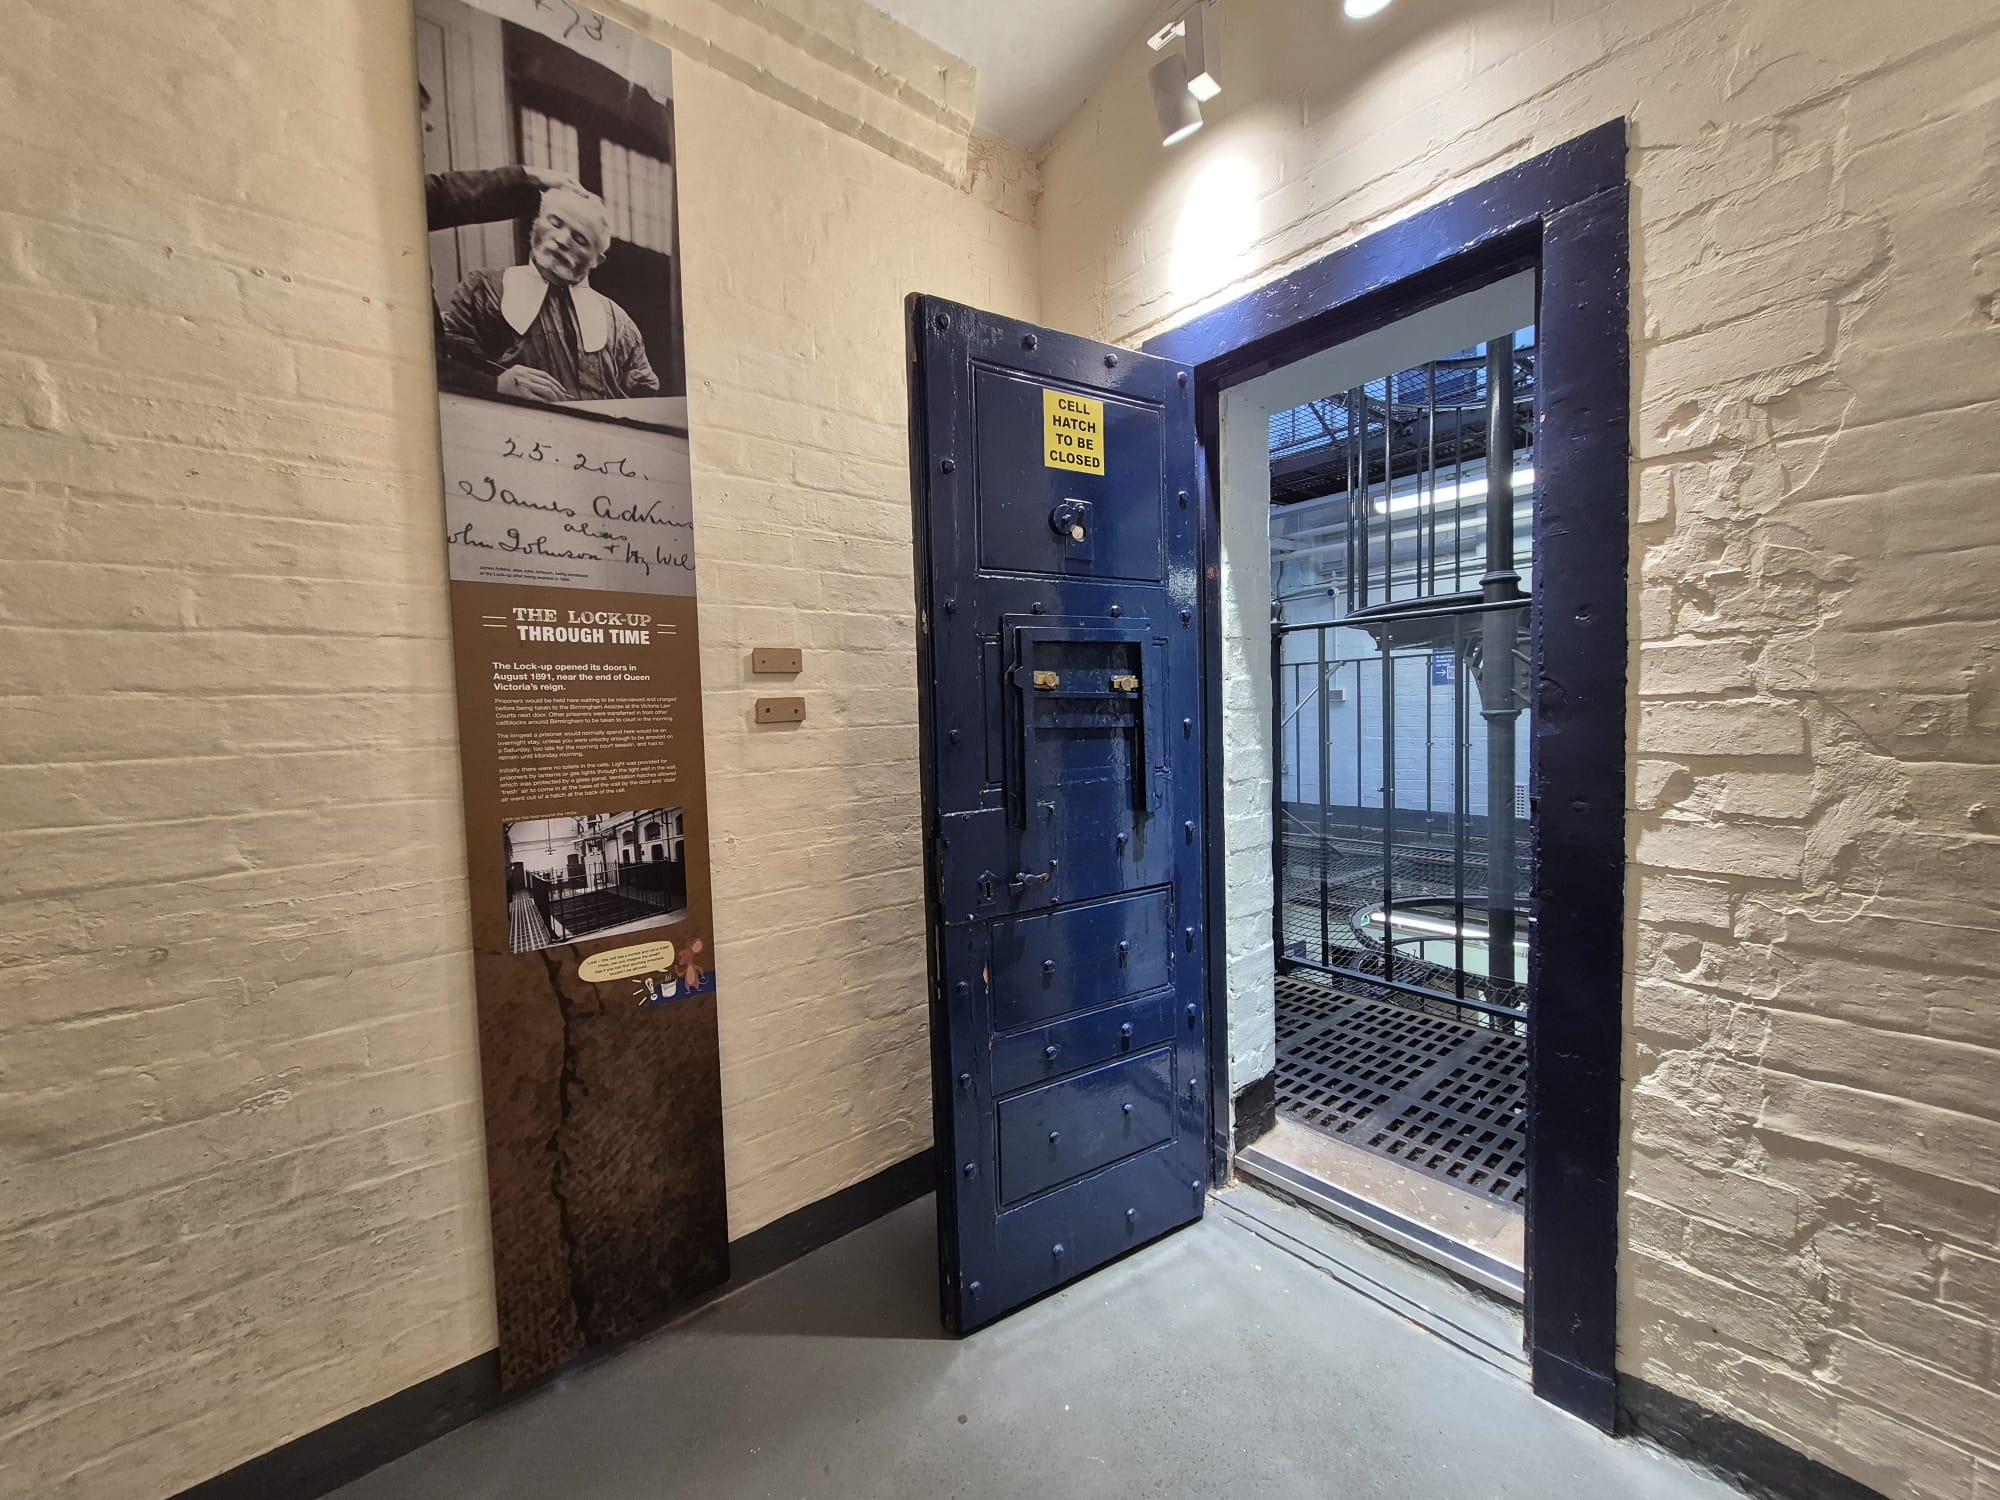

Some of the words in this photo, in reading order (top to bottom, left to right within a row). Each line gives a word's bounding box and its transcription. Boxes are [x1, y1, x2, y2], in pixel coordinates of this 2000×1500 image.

[1058, 399, 1090, 415] CELL
[1053, 415, 1095, 433] HATCH
[1056, 433, 1072, 446] TO
[1078, 437, 1093, 450] BE
[1050, 450, 1100, 468] CLOSED
[512, 608, 557, 622] THE
[568, 610, 652, 626] LOCK-UP
[517, 625, 604, 643] THROUGH
[609, 629, 650, 644] TIME
[492, 662, 511, 670] The
[514, 663, 552, 671] Lock-up
[494, 673, 527, 681] August
[531, 673, 554, 681] 1891,
[540, 683, 566, 691] reign.
